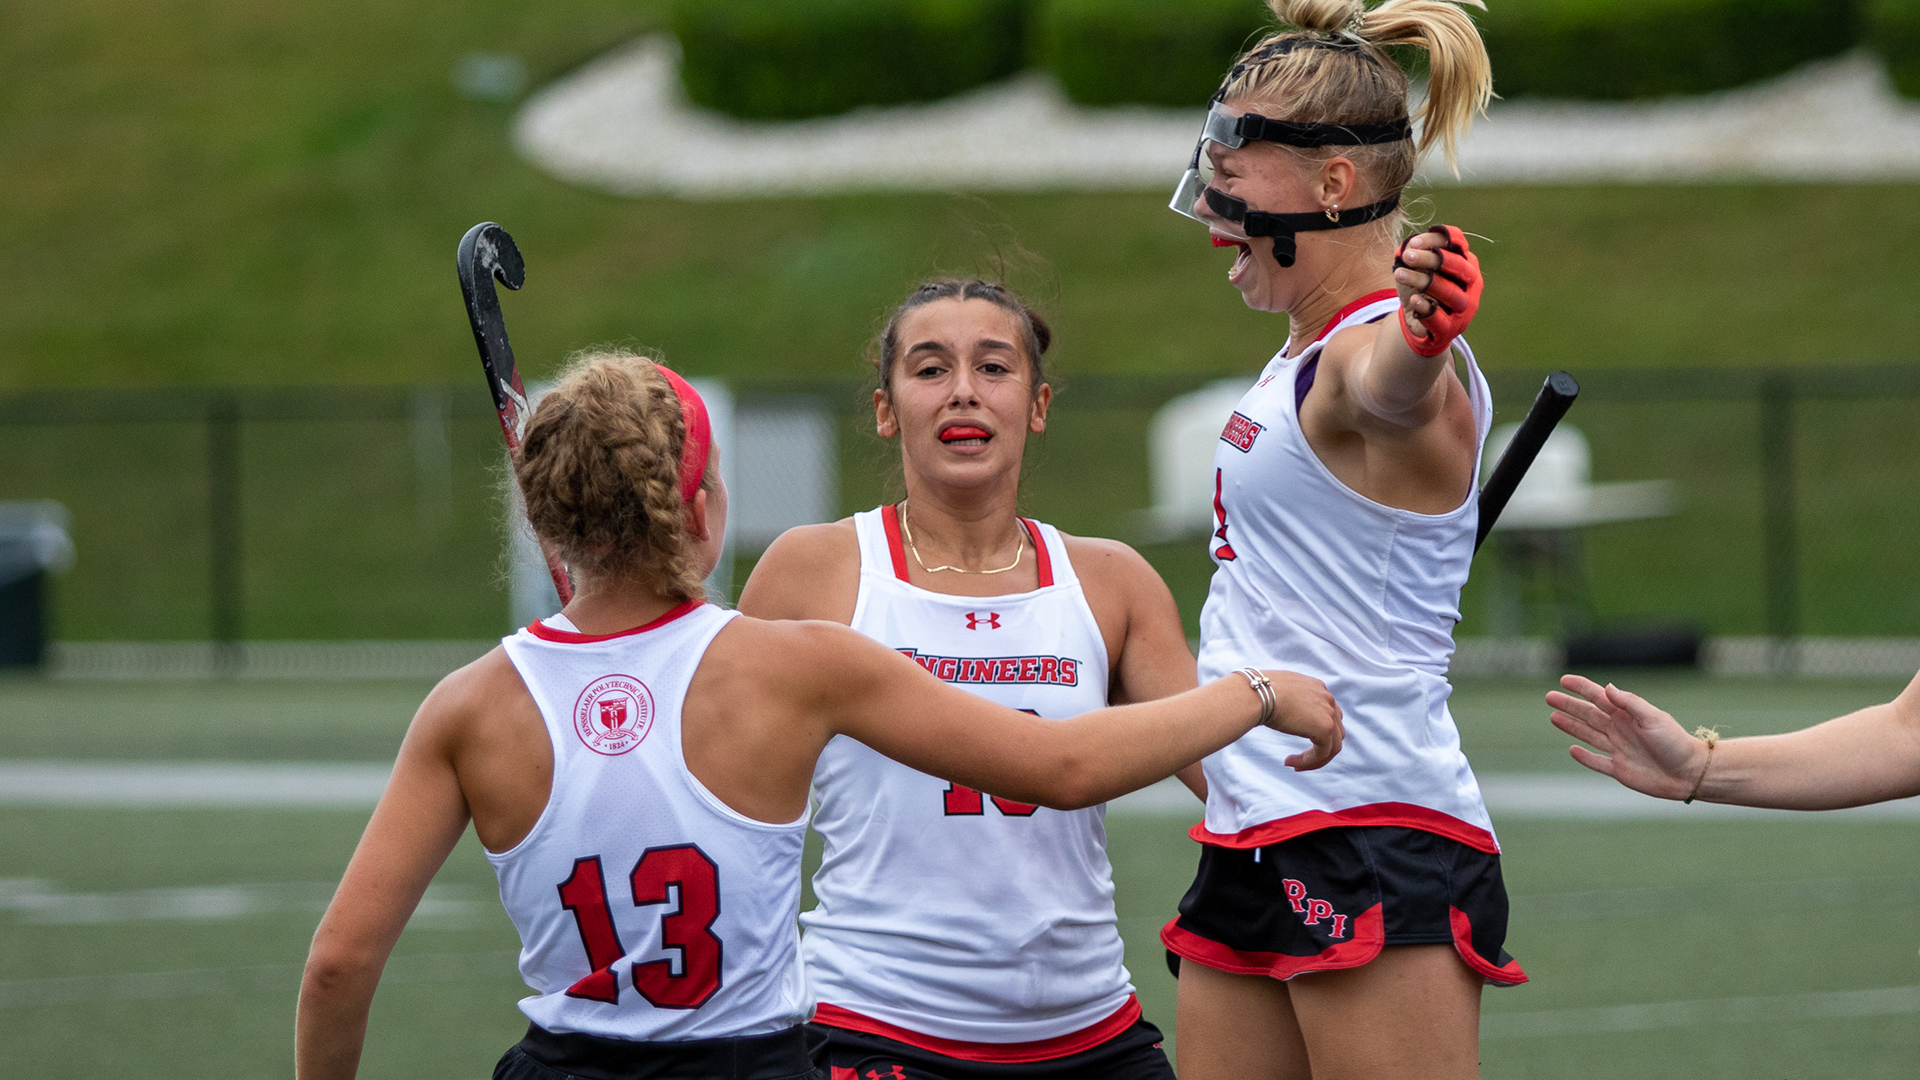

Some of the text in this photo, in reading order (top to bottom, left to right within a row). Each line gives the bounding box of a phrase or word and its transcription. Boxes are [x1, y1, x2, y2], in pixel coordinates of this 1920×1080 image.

[894, 648, 1079, 687] NGINEERS
[581, 681, 648, 737] RENSSELAER POLYTECHNIC INSTITUTE
[609, 741, 625, 750] 1824
[556, 842, 723, 1010] 13
[1282, 879, 1348, 938] RPI
